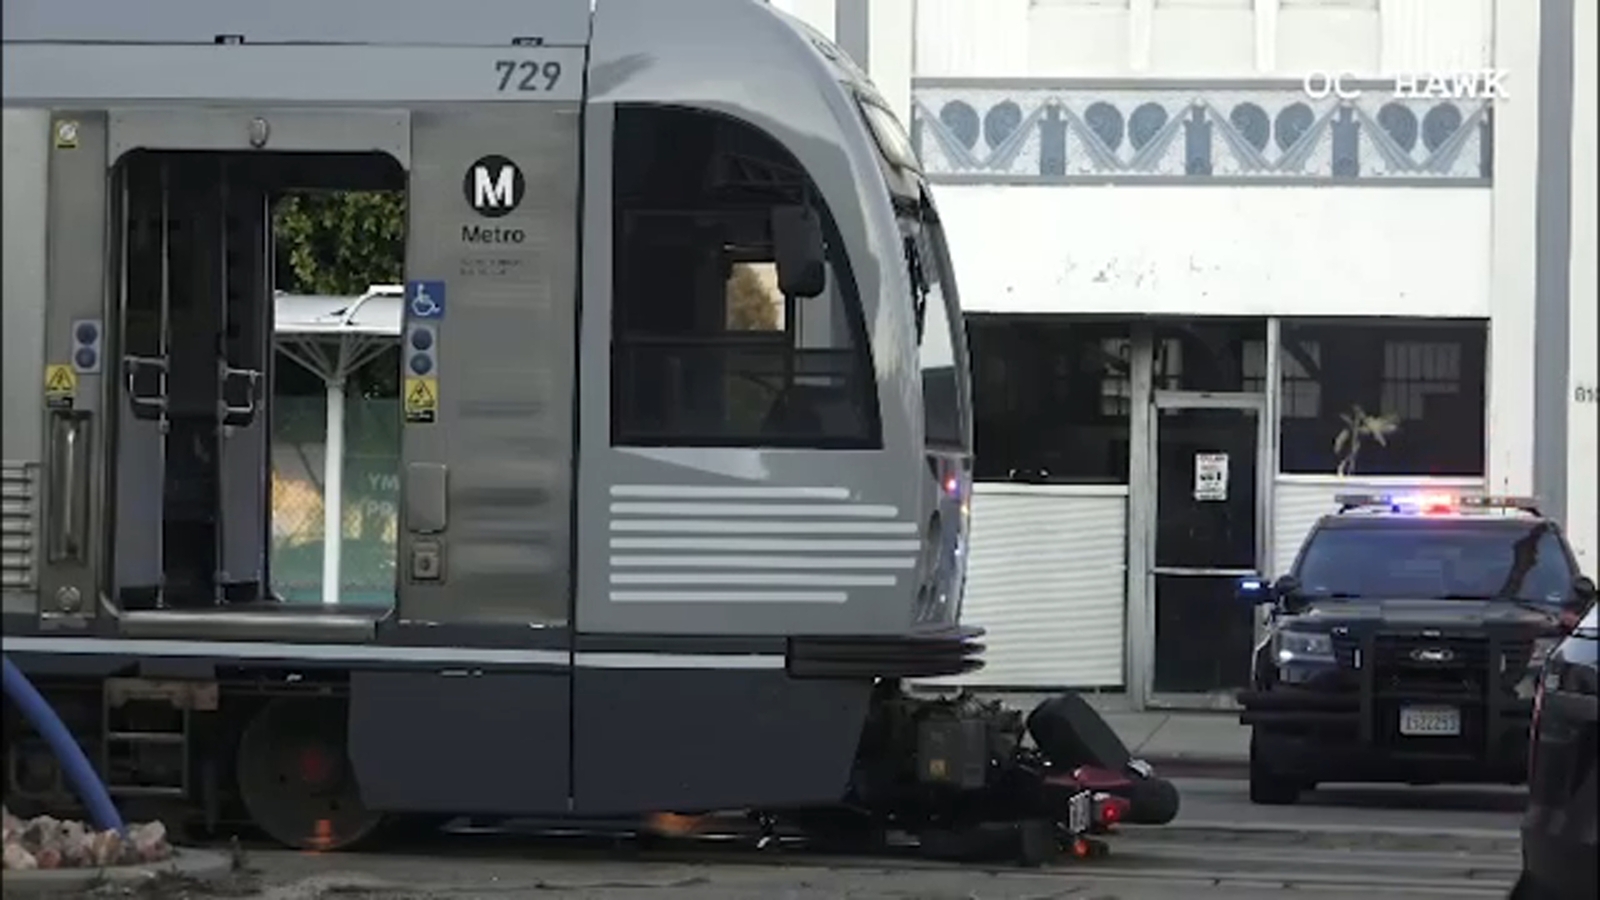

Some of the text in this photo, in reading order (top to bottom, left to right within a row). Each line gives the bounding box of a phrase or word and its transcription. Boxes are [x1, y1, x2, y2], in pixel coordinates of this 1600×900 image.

[496, 61, 561, 91] 729
[474, 165, 514, 207] M
[461, 225, 525, 243] Metro
